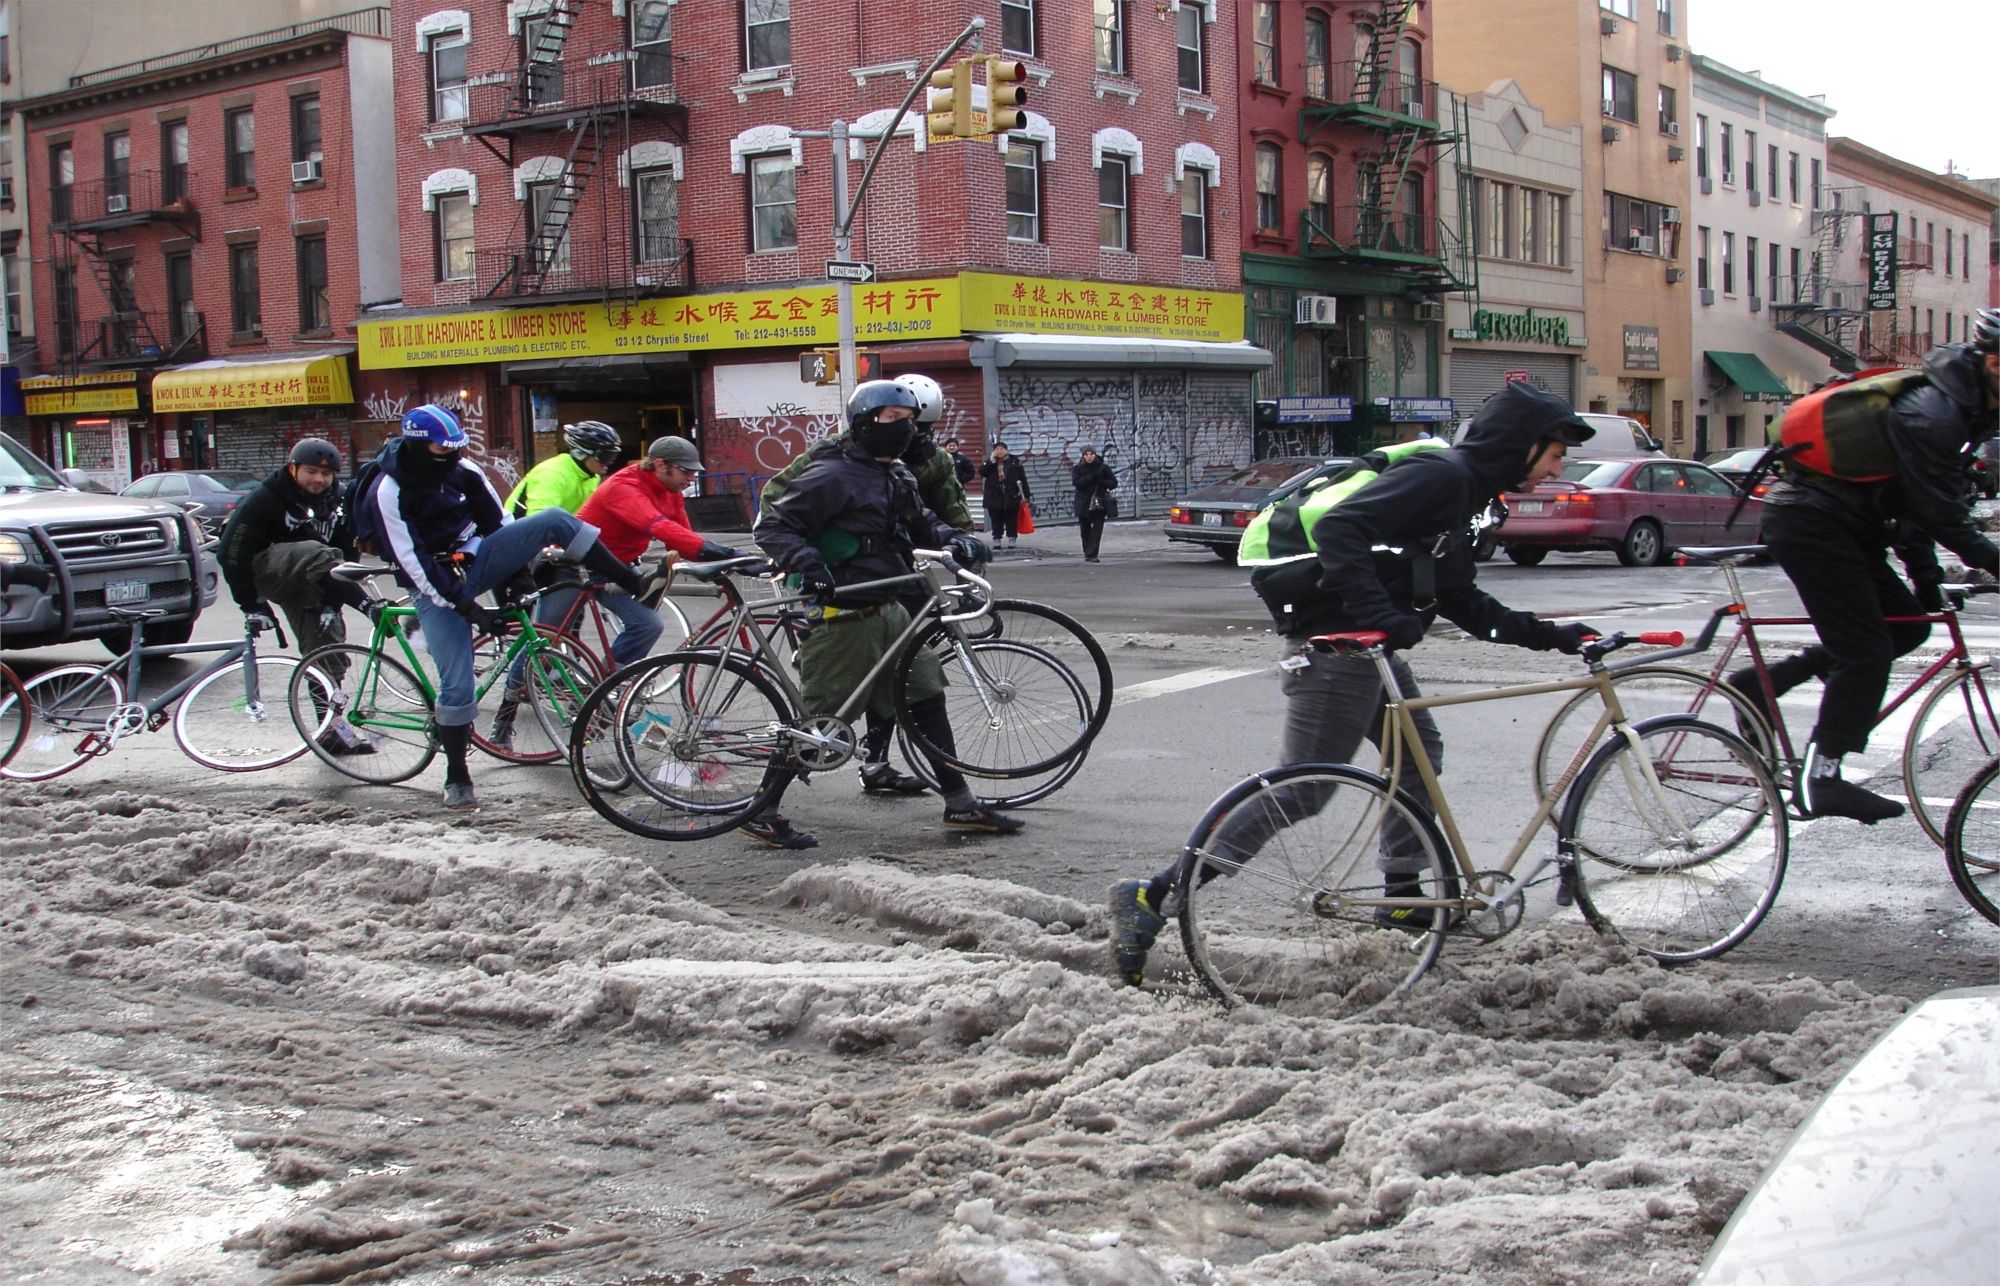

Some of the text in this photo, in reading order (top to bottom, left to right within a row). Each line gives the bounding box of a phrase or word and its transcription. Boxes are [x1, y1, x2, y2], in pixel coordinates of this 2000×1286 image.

[833, 267, 868, 277] ONE WAY
[1040, 307, 1108, 320] HARDWARE
[1113, 311, 1121, 321] &
[1126, 312, 1169, 325] LUMBER
[1174, 315, 1207, 327] STORE
[427, 319, 485, 344] HARDWARE
[489, 319, 496, 339] &
[501, 315, 544, 339] LUMBER
[549, 311, 588, 337] STORE
[1041, 321, 1065, 330] BUILDING
[1475, 307, 1569, 345] Greenberg
[615, 337, 628, 347] 123
[646, 333, 680, 347] Chrystie
[683, 333, 709, 344] Street
[735, 326, 817, 340] Tel: 212-431-5558
[407, 350, 437, 361] BUILDING
[441, 348, 479, 359] MATERIALS
[484, 346, 519, 356] PLUMBING
[523, 345, 528, 353] &
[531, 342, 567, 352] ELECTRIC
[156, 389, 173, 400] KWOK
